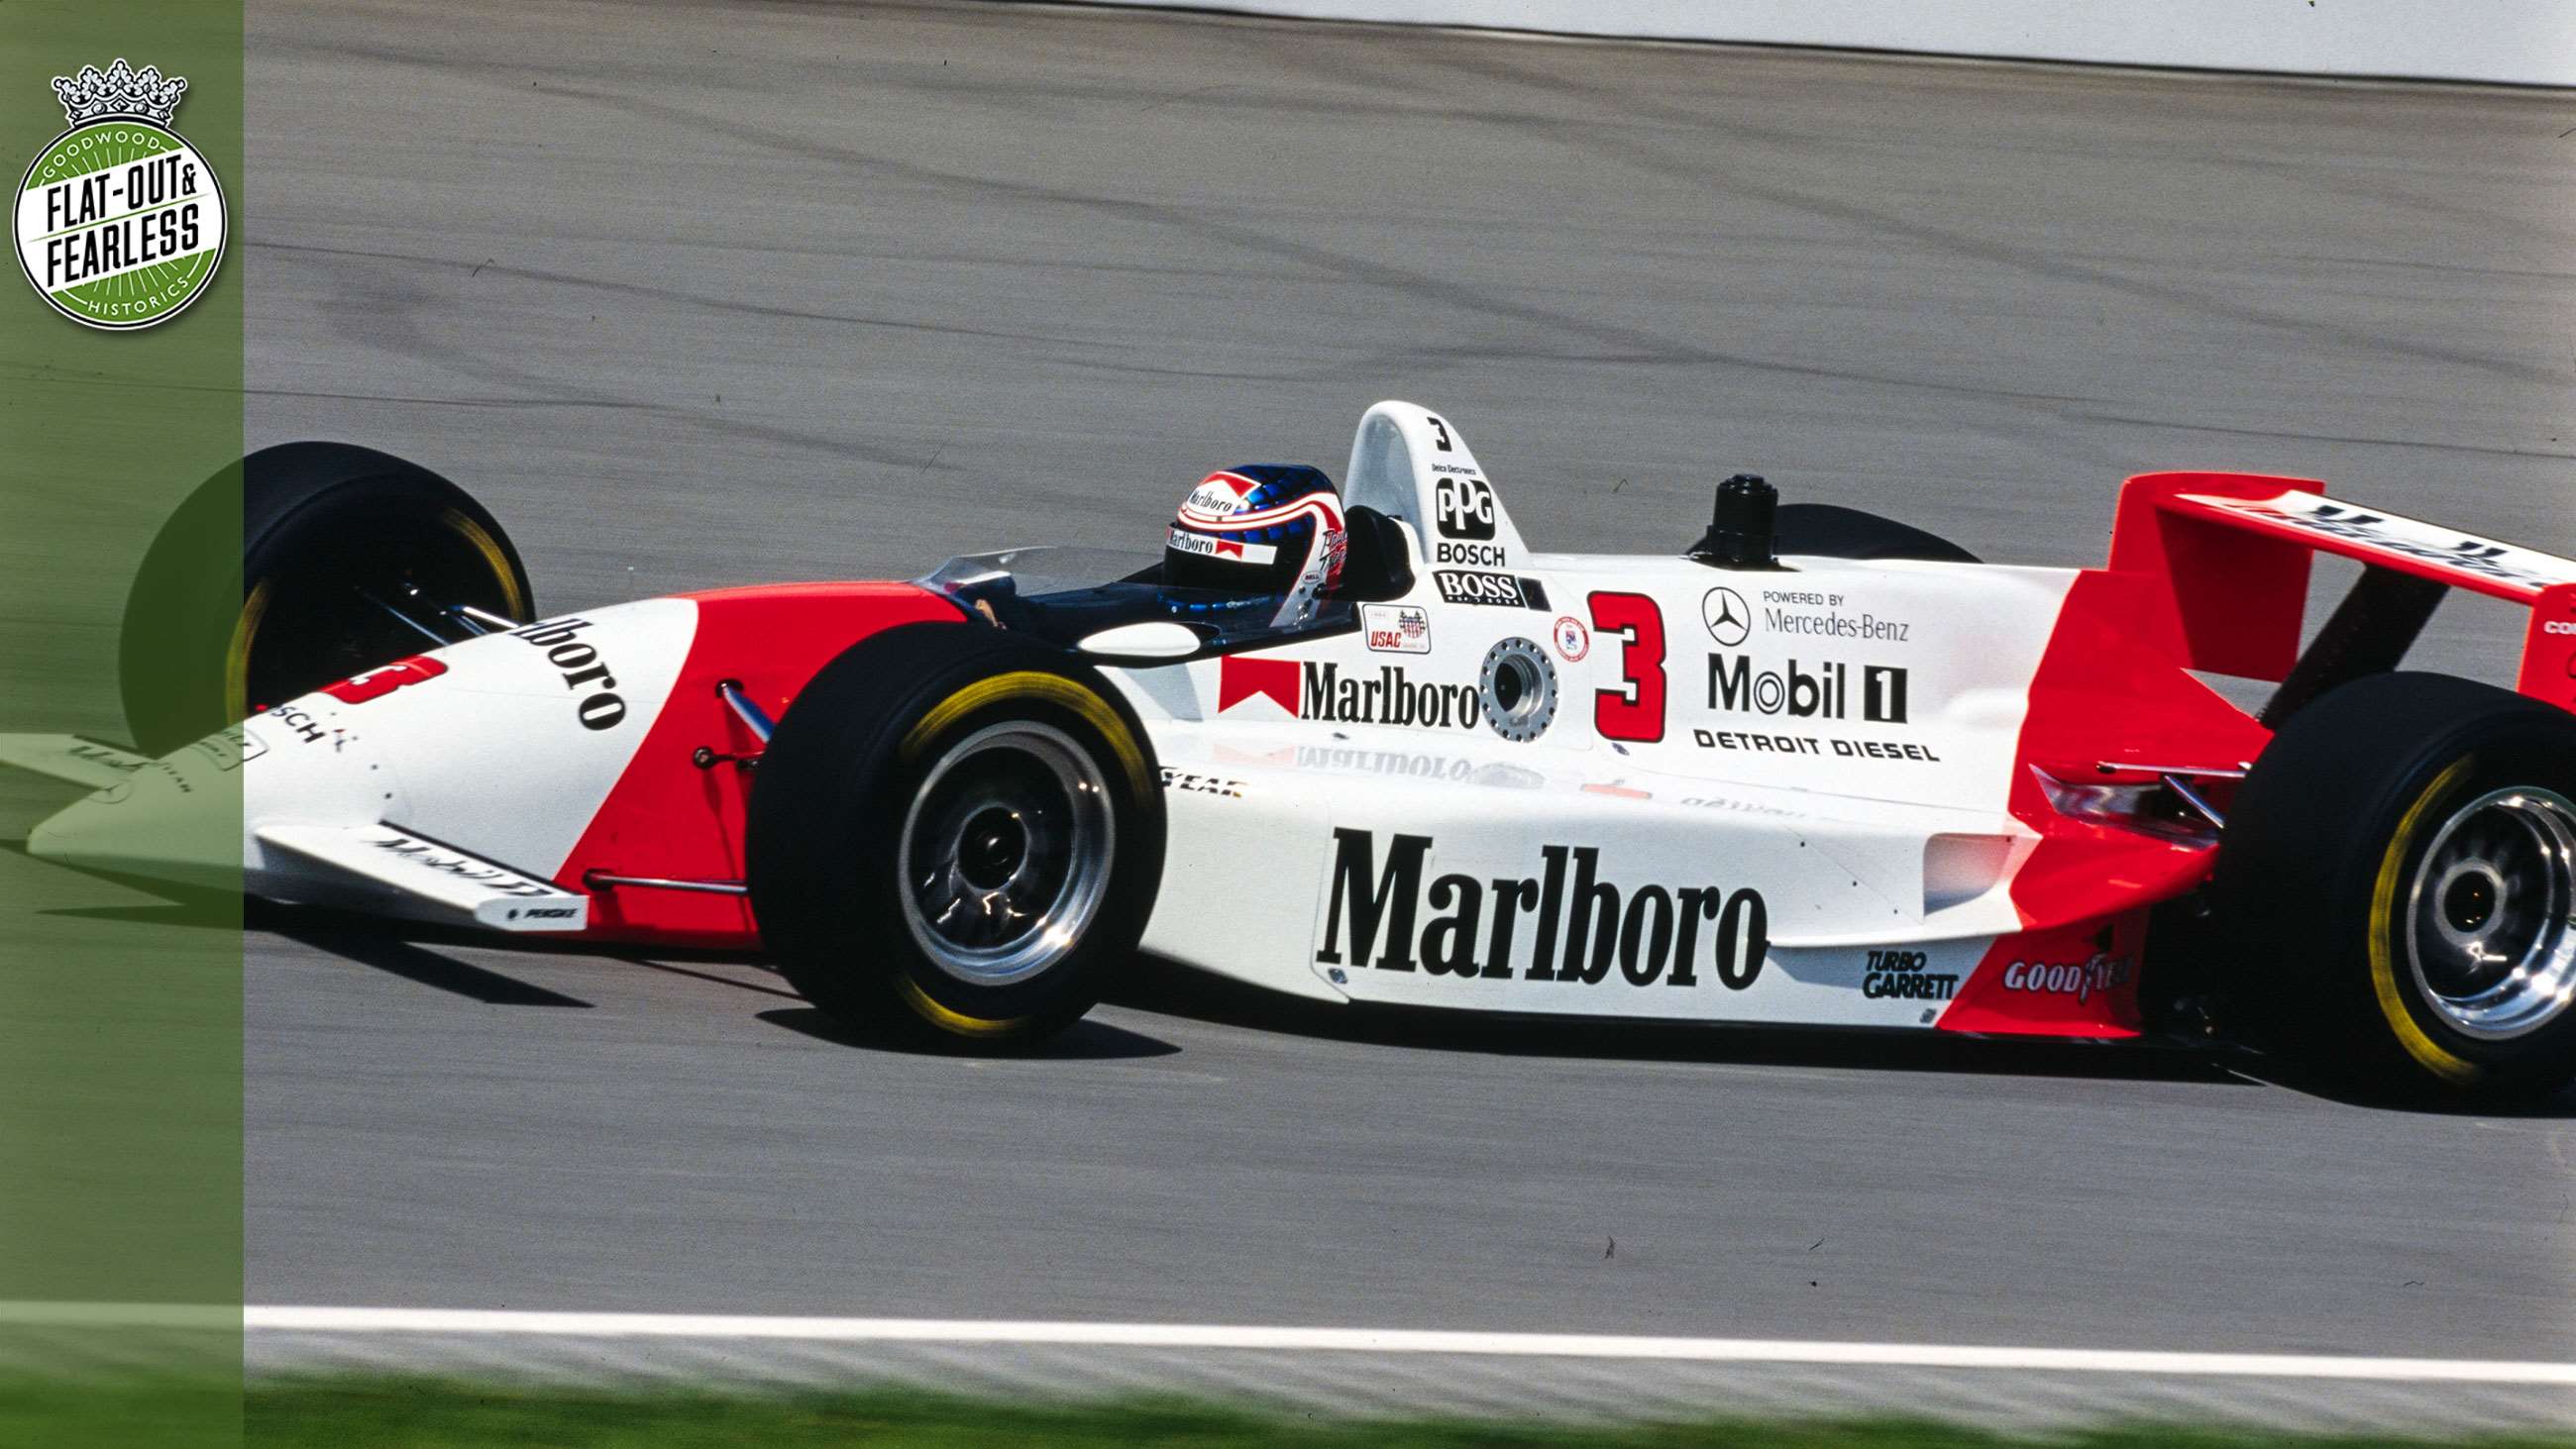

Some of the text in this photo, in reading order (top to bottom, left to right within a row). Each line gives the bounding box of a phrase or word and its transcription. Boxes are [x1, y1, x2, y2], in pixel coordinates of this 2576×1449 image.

[1427, 417, 1451, 452] 3
[1437, 543, 1506, 567] BOSCH
[1439, 572, 1518, 599] BOSS
[1764, 591, 1845, 606] POWERED BY
[1371, 631, 1402, 648] USAC
[1765, 607, 1910, 642] Mercedes-Benz
[1587, 590, 1666, 744] 3
[1301, 661, 1480, 729] Marlboro
[1707, 653, 1845, 720] Mobil
[270, 704, 326, 744] SCH
[1692, 729, 1941, 762] DETROIT DIESEL
[1316, 826, 1769, 990] Marlboro
[1866, 951, 1927, 972] TURBO
[1863, 973, 1959, 1000] GARRETT
